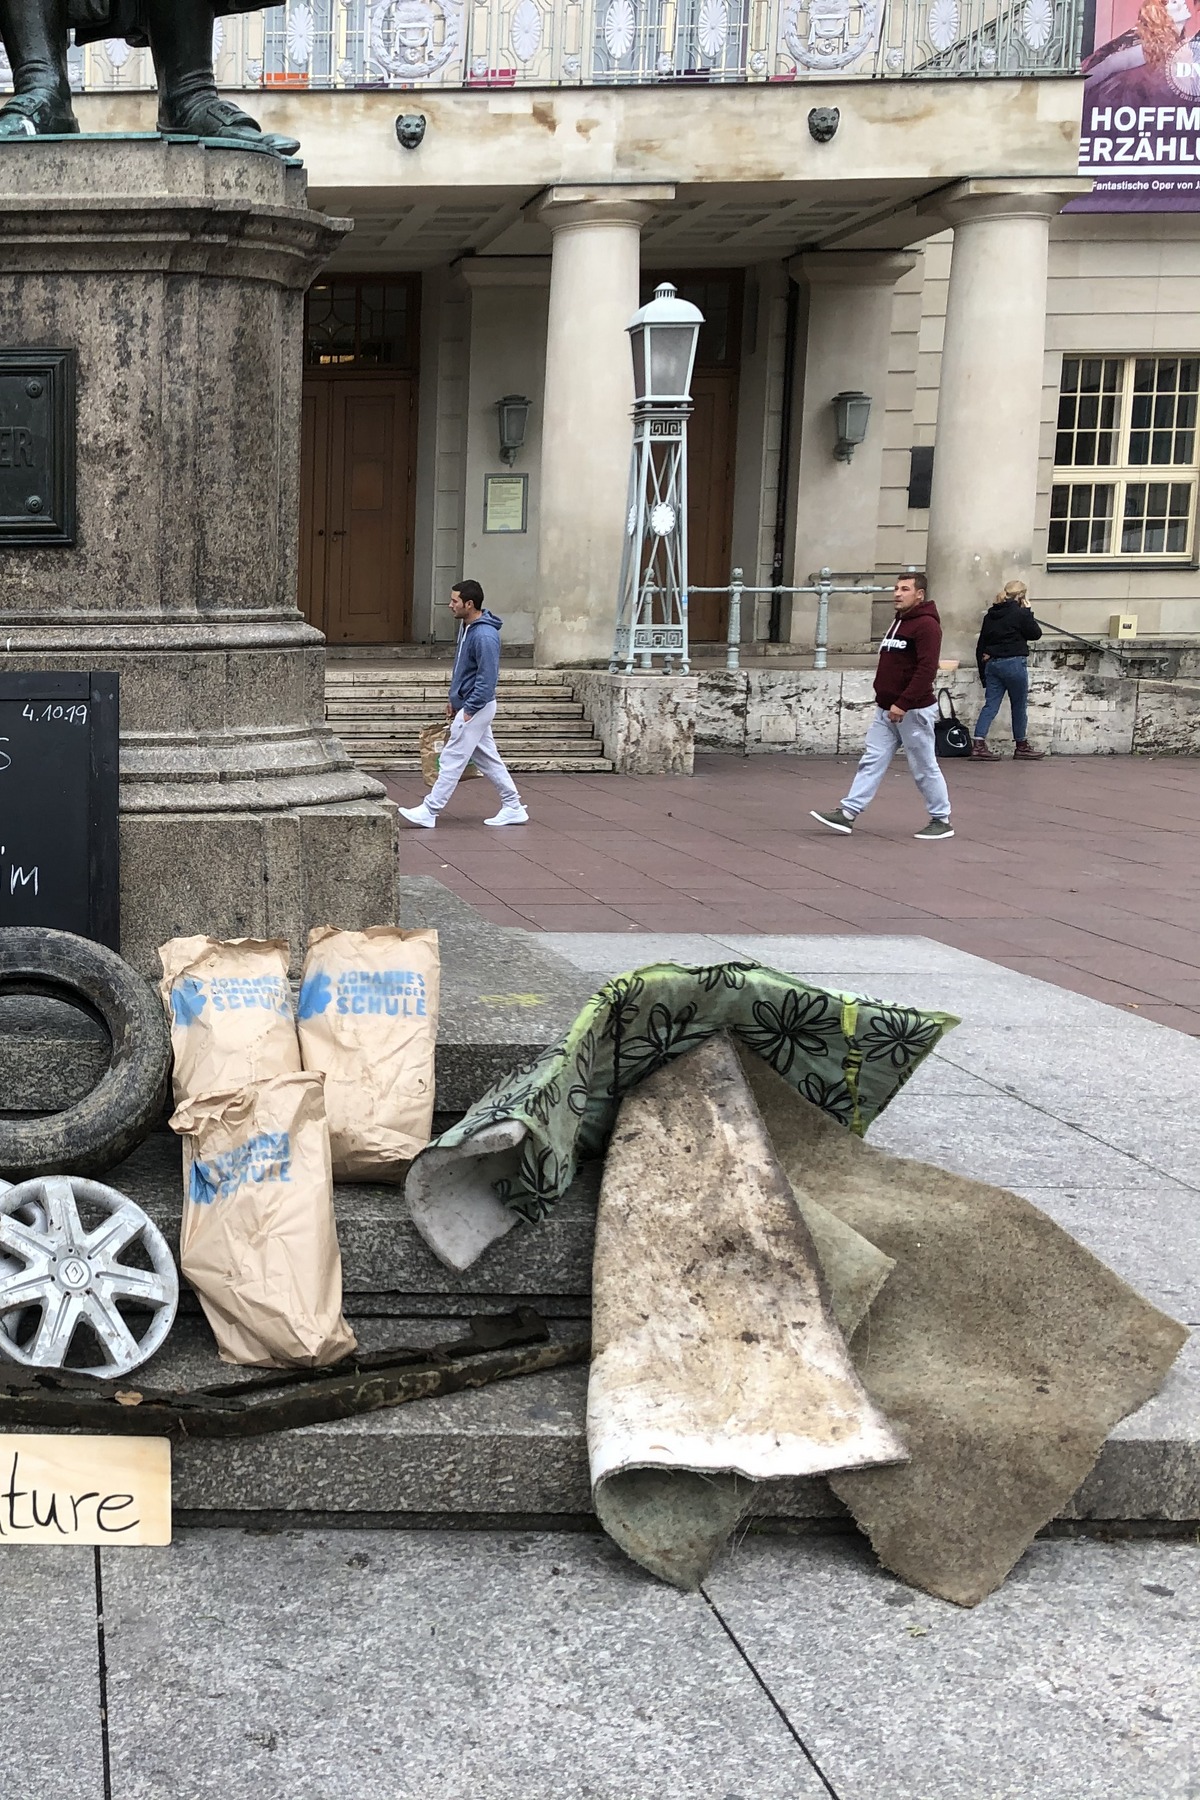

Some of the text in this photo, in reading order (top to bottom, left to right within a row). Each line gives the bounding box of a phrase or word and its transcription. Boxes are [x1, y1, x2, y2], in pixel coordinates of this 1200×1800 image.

[1078, 132, 1200, 162] ERZÄHL
[1092, 181, 1149, 191] Fantastische
[1152, 180, 1174, 191] Oper
[1177, 182, 1193, 190] von
[337, 971, 425, 987] JOHANNES
[336, 996, 426, 1016] SCHULE
